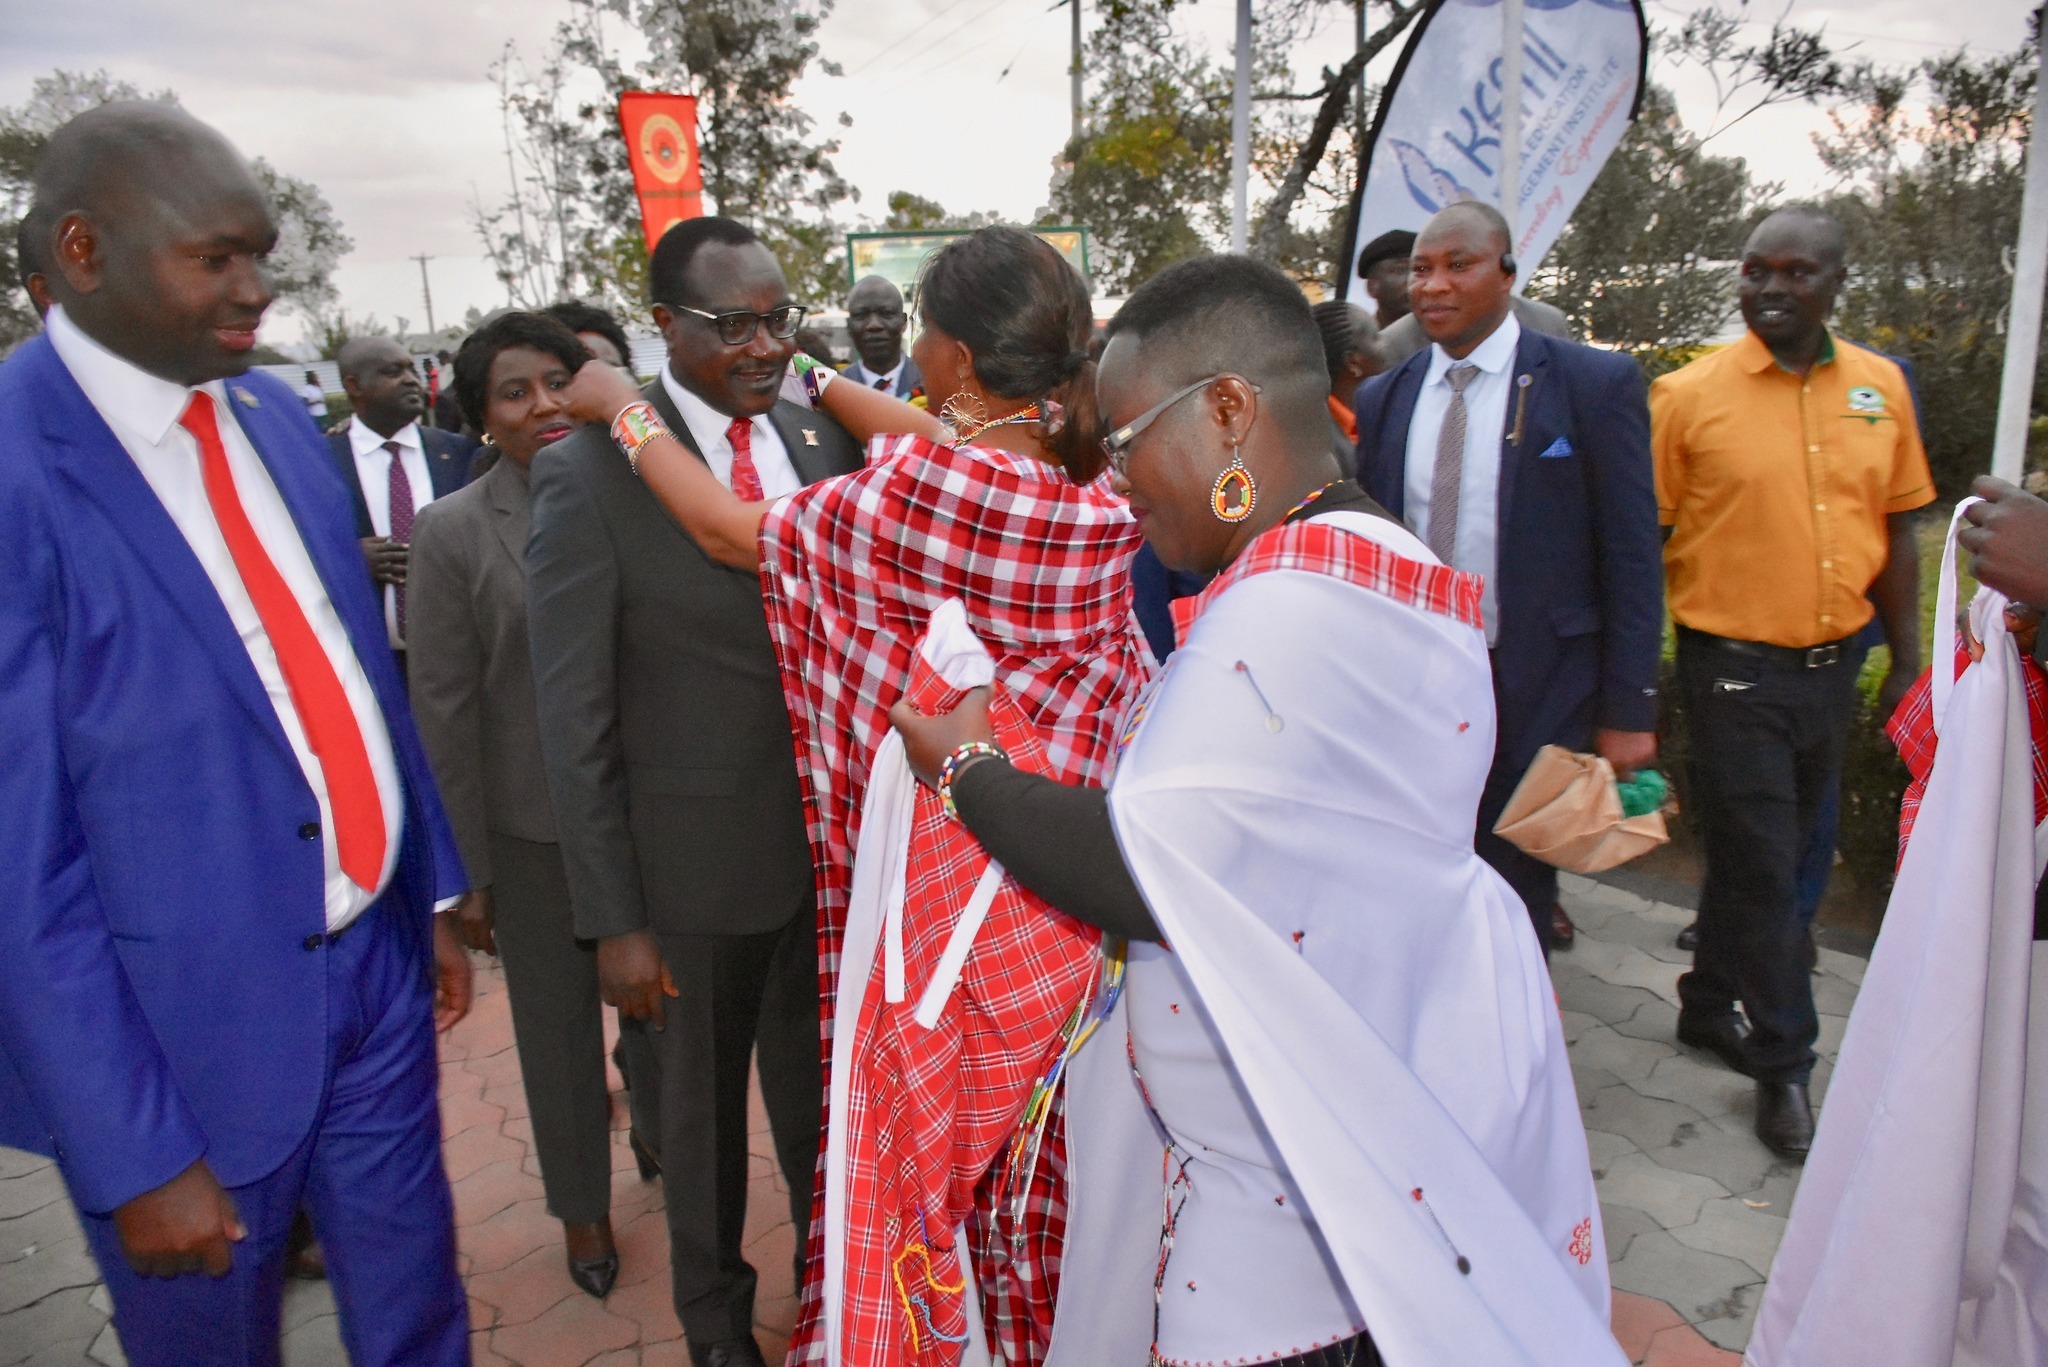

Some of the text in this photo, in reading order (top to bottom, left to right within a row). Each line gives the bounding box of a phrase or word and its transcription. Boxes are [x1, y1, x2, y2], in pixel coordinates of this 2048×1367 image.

[1519, 56, 1619, 206] AGEMENT INSTITUTE
[1525, 65, 1588, 151] EDUCATION
